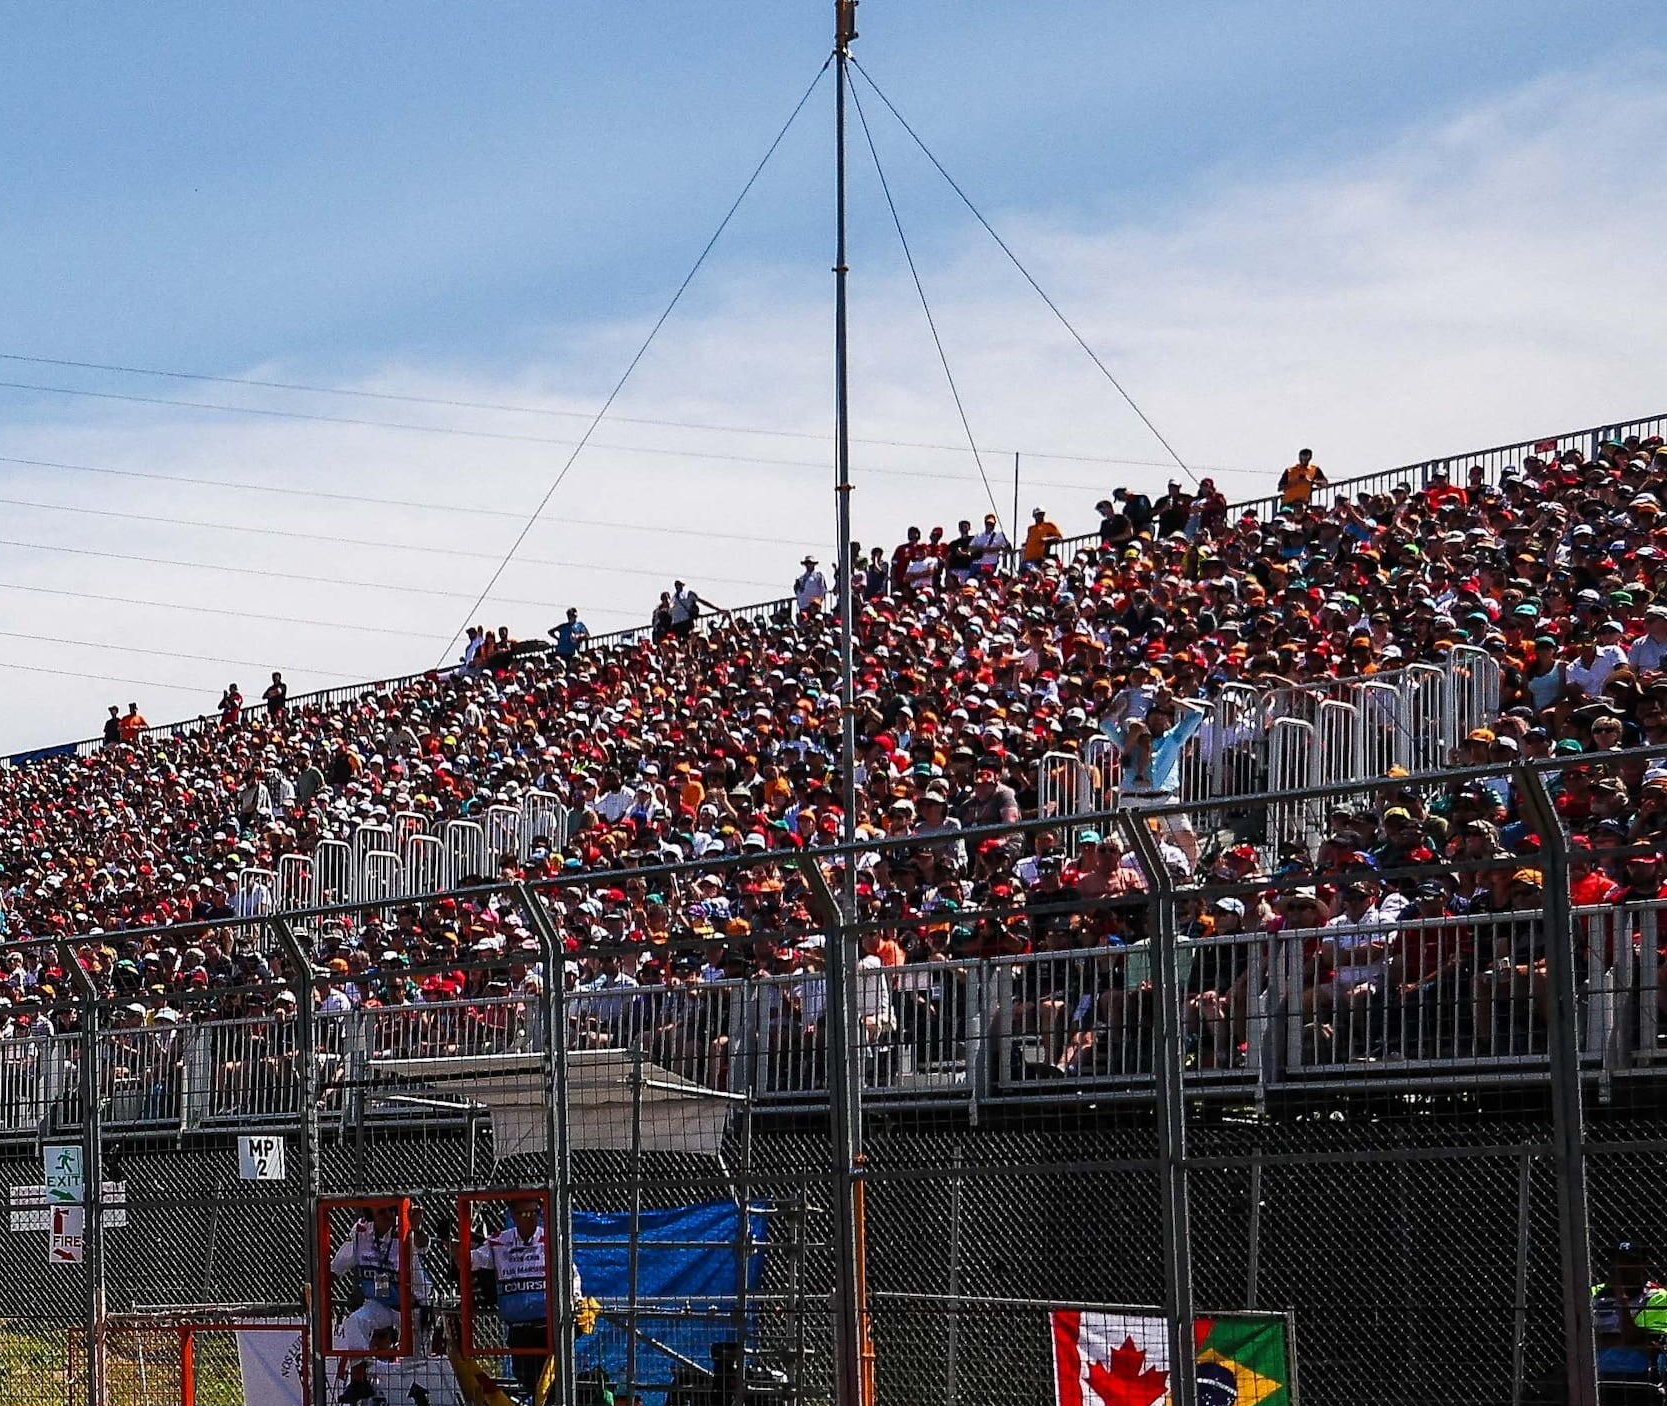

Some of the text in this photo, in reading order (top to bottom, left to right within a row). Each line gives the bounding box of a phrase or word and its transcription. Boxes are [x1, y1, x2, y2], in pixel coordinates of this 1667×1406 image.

[249, 1140, 274, 1157] MP
[258, 1159, 267, 1176] 2
[47, 1175, 80, 1187] EXIT
[54, 1236, 81, 1247] FIRE
